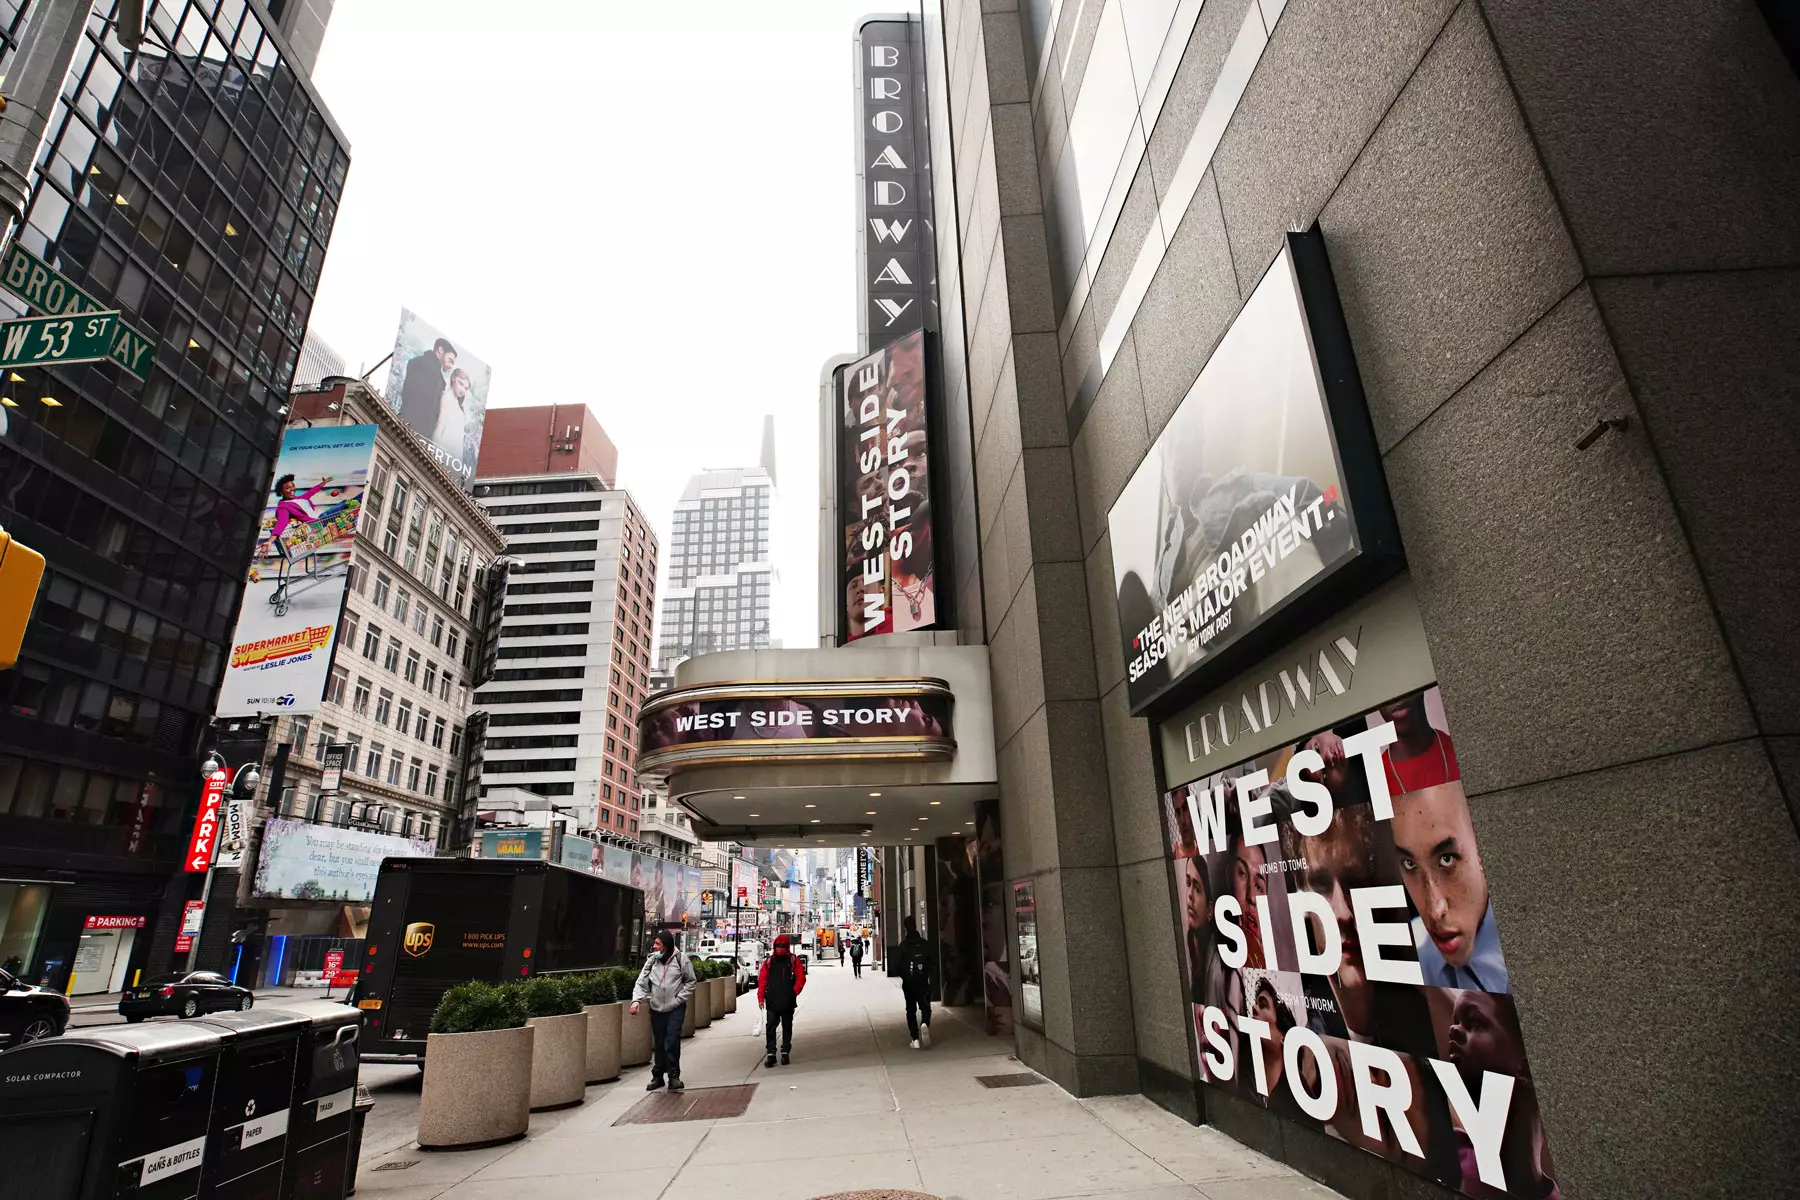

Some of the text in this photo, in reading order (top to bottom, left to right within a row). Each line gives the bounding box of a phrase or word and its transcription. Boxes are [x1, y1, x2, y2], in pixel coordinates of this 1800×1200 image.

[869, 45, 914, 327] BROADWAY
[6, 251, 148, 369] BROAAY
[2, 318, 111, 361] W 53 ST
[886, 407, 913, 560] STORY
[859, 361, 886, 633] WEST SIDE
[1163, 585, 1194, 632] NEW
[1195, 484, 1297, 602] BROADWAY
[1189, 569, 1248, 633] MAJOR
[234, 630, 308, 655] SUPERMARKET
[1187, 607, 1232, 657] NEW YORK POST
[260, 659, 286, 671] LESLIE
[286, 653, 313, 665] JONES
[1183, 625, 1363, 763] BROADWAY
[675, 707, 911, 732] WEST SIDE STORY
[325, 759, 342, 767] SPACE
[1186, 720, 1398, 856] WEST
[195, 793, 220, 853] PARK
[306, 835, 318, 846] You
[320, 841, 335, 850] may
[329, 852, 340, 864] but
[1259, 857, 1310, 875] WOMB TO TOMB.
[97, 917, 137, 926] PARKING
[406, 933, 431, 951] ups
[1214, 885, 1425, 986] SIDE
[1310, 997, 1337, 1013] WORM.
[5, 1070, 82, 1082] SOLAR COMPACTOR
[319, 1101, 334, 1113] TRASH
[1202, 1004, 1515, 1193] STORY
[246, 1127, 263, 1139] PAPER
[147, 1148, 200, 1174] CANS & BOTTLES
